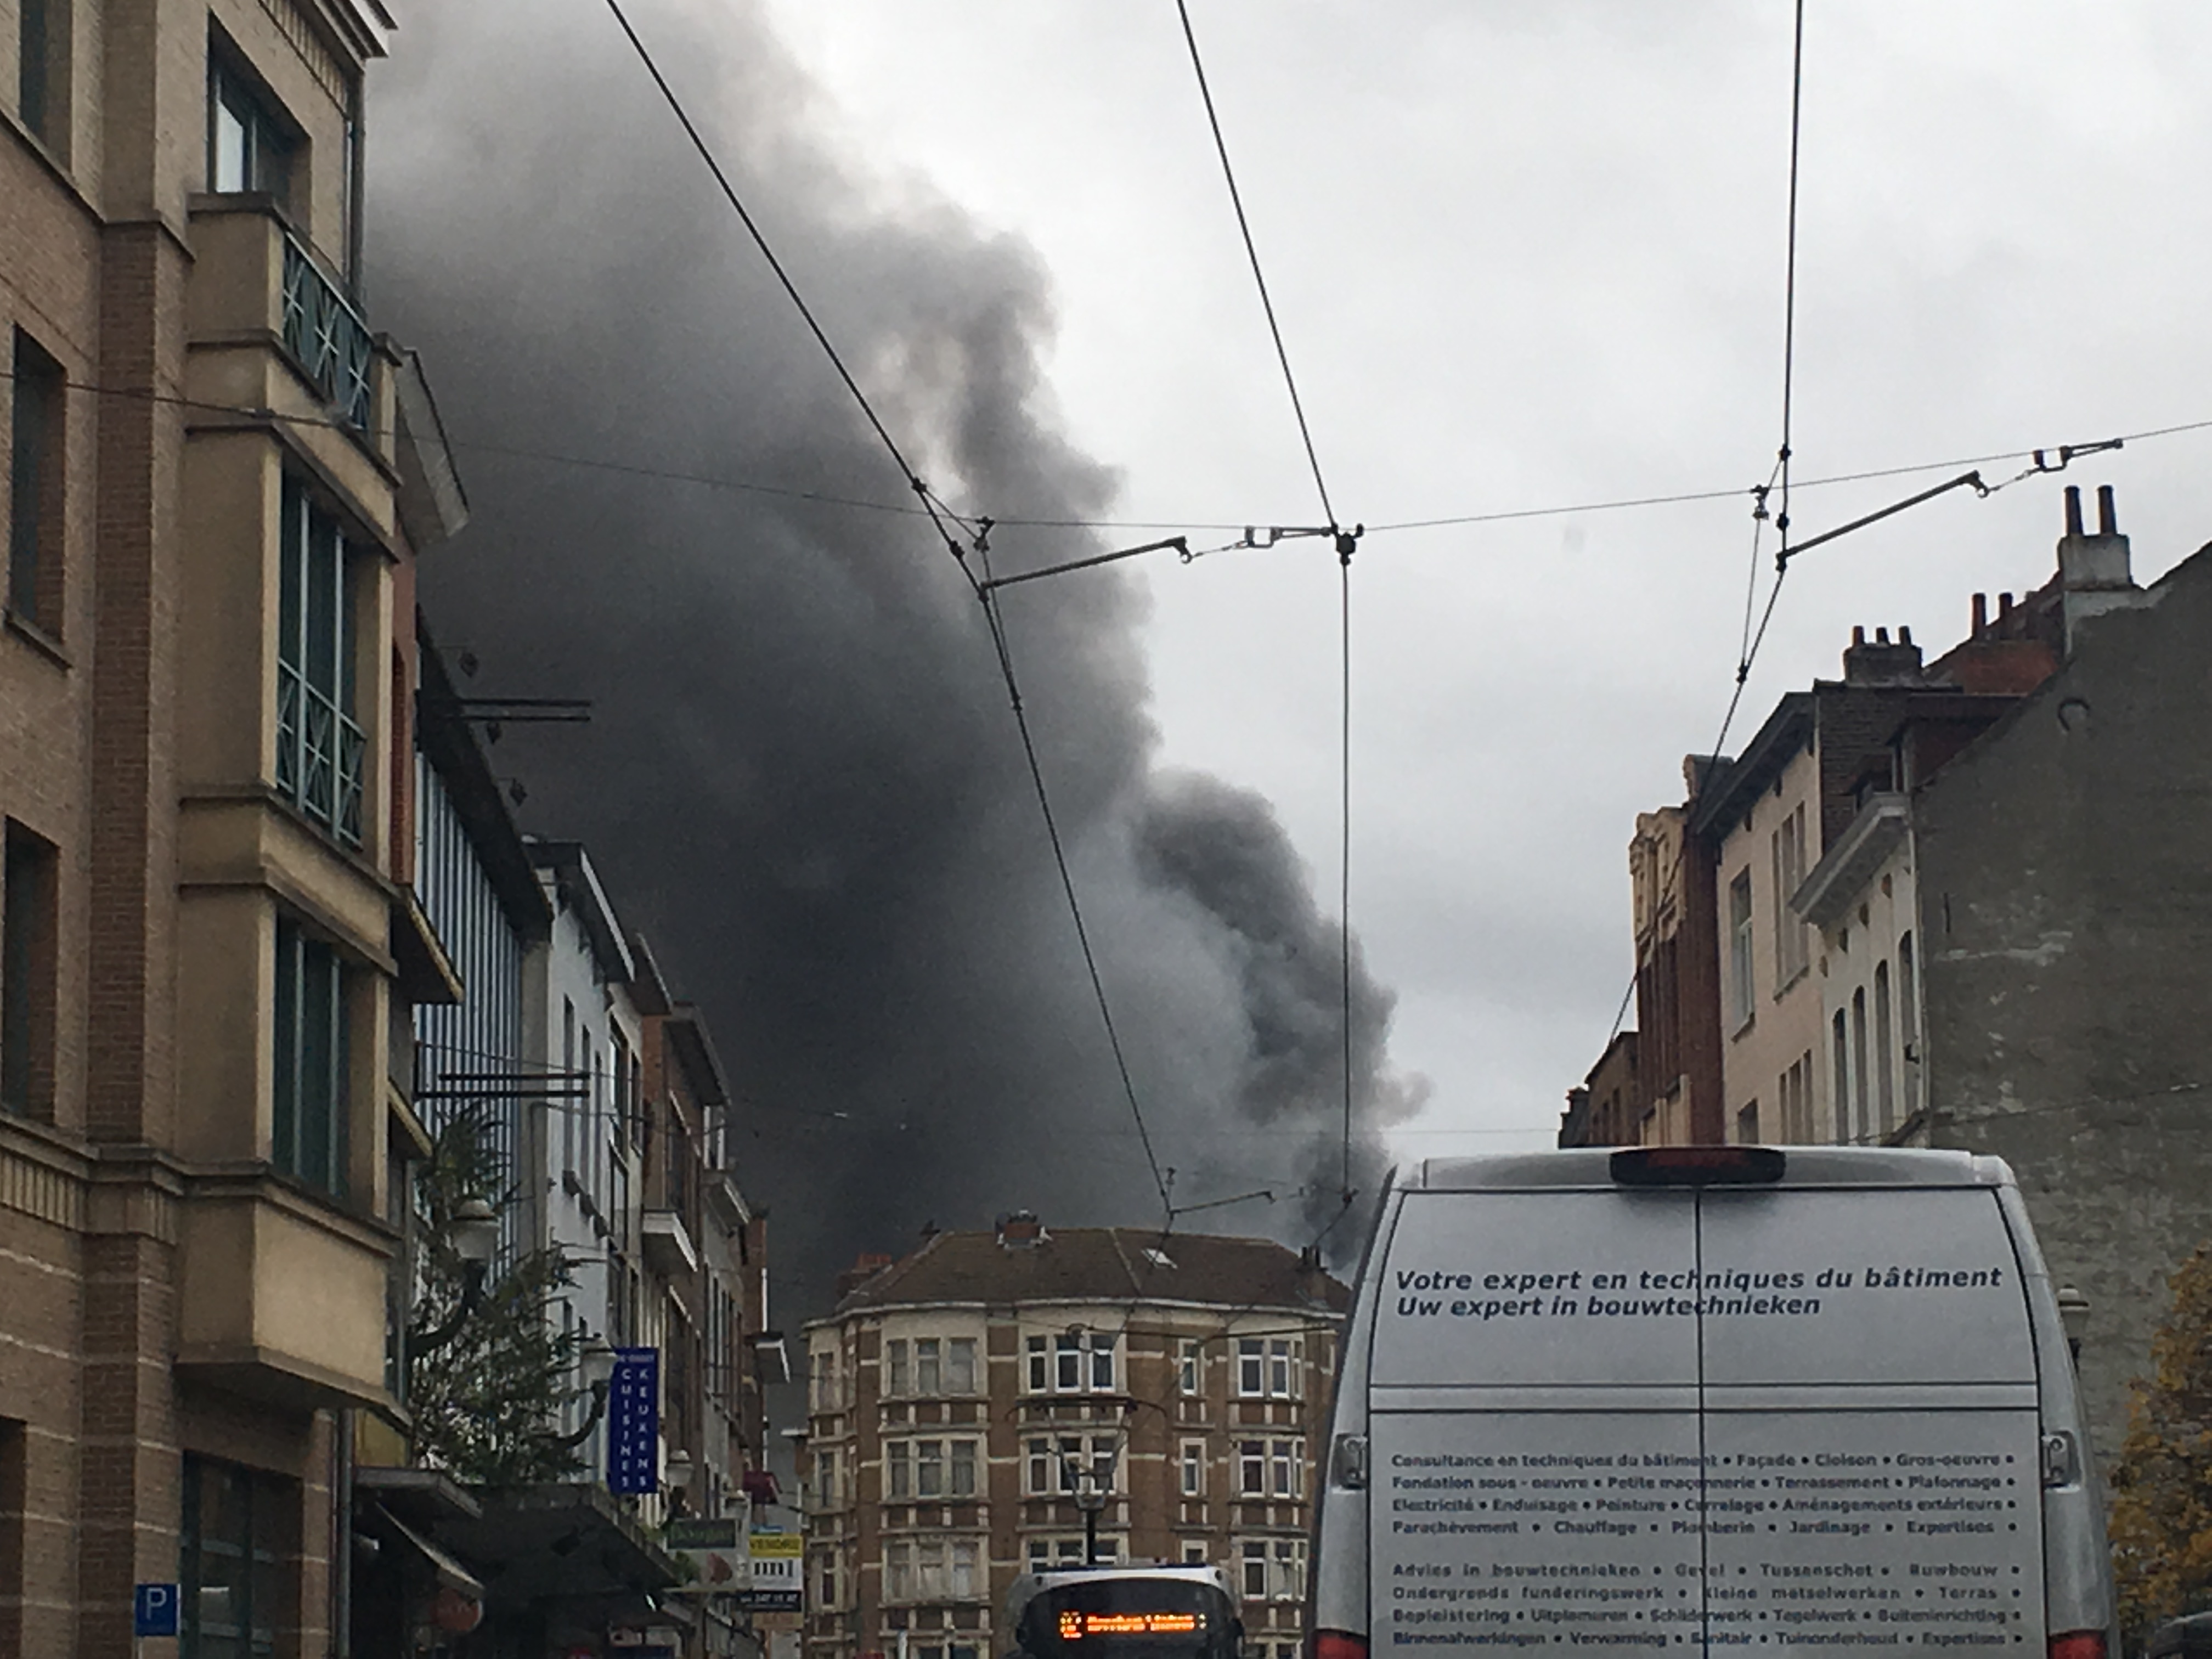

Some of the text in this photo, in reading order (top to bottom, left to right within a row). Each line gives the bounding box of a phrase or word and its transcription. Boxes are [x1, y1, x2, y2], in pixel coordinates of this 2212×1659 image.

[1396, 1266, 2003, 1294] Votre expert en techniques du bâtiment
[1397, 1295, 1821, 1320] Uw expert in bouwtechnieken
[1391, 1454, 1495, 1468] Consultance
[1497, 1455, 1519, 1468] en
[1521, 1453, 1613, 1470] techniques
[1617, 1453, 1639, 1467] du
[1736, 1453, 1797, 1470] Façade
[1392, 1475, 1475, 1490] Fondation
[1478, 1478, 1517, 1490] sous
[1607, 1476, 1656, 1490] Petite
[1774, 1476, 1891, 1489] Terrassement
[1908, 1474, 2002, 1491] Plafonnage
[1595, 1498, 1668, 1513] Peinture
[1782, 1497, 1913, 1514] Aménagements
[1553, 1520, 1638, 1536] Chauffage
[1906, 1520, 1995, 1536] Expertises
[1392, 1562, 1452, 1578] Advies
[1463, 1562, 1481, 1578] in
[1909, 1562, 1999, 1577] Ruwbouw
[1392, 1586, 1509, 1602] Ondergronds
[1521, 1585, 1664, 1602] funderingswerk
[1771, 1585, 1901, 1600] metselwerken
[1938, 1585, 1998, 1600] Terras
[146, 1587, 167, 1621] P
[1772, 1608, 1857, 1624] Tegelwerk
